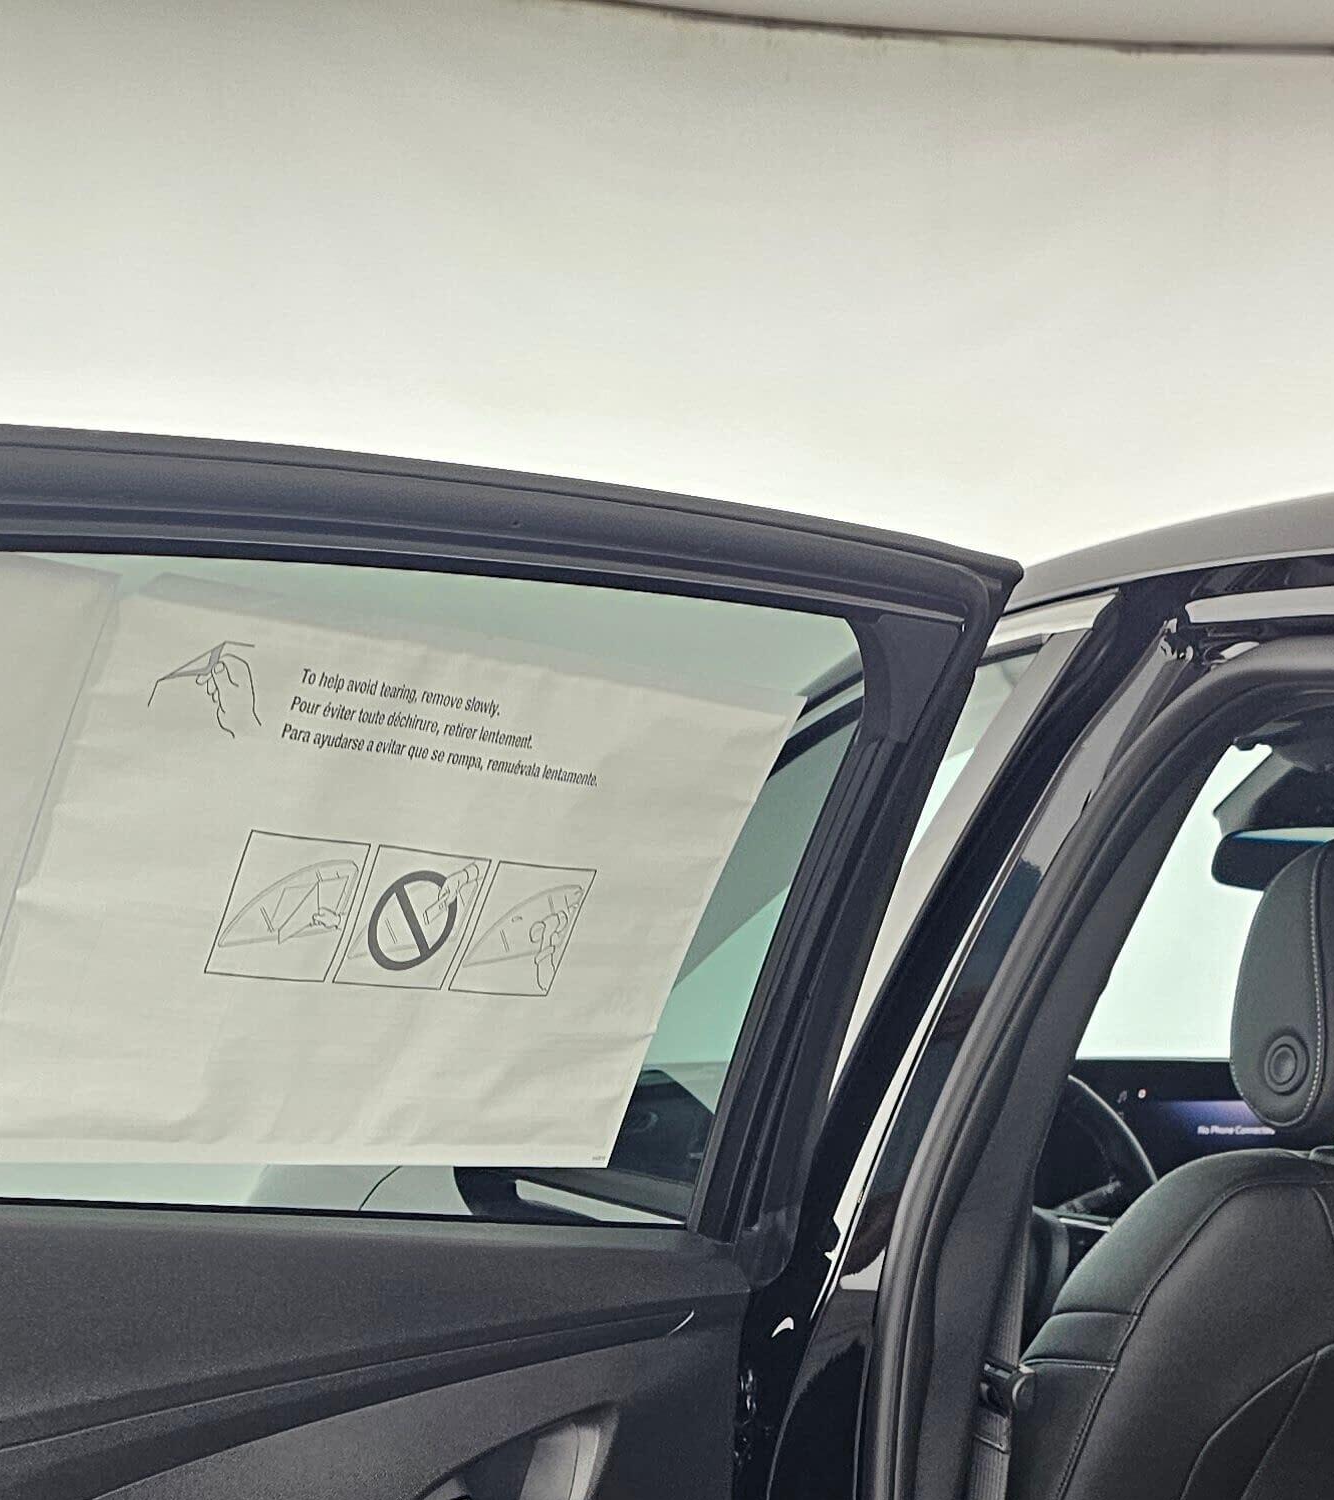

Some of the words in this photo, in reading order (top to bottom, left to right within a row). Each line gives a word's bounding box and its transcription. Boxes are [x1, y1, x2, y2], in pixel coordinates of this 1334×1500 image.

[302, 668, 316, 685] To
[318, 671, 345, 693] help
[346, 678, 379, 696] avoid
[379, 682, 419, 704] tearing,
[420, 690, 463, 709] remove
[464, 696, 501, 719] slowly.
[290, 695, 322, 716] Pour
[322, 701, 357, 721] éviter
[358, 707, 386, 726] toute
[386, 711, 441, 737] déchirure,
[443, 722, 479, 741] retirer
[479, 726, 533, 749] lentement.
[281, 723, 311, 743] Para
[313, 732, 365, 750] ayudarse
[366, 739, 375, 753] a
[375, 738, 407, 757] evitar
[407, 744, 429, 761] que
[430, 748, 445, 763] se
[446, 752, 484, 771] rompa,
[486, 758, 541, 779] remuévala
[541, 764, 599, 788] lentamente.
